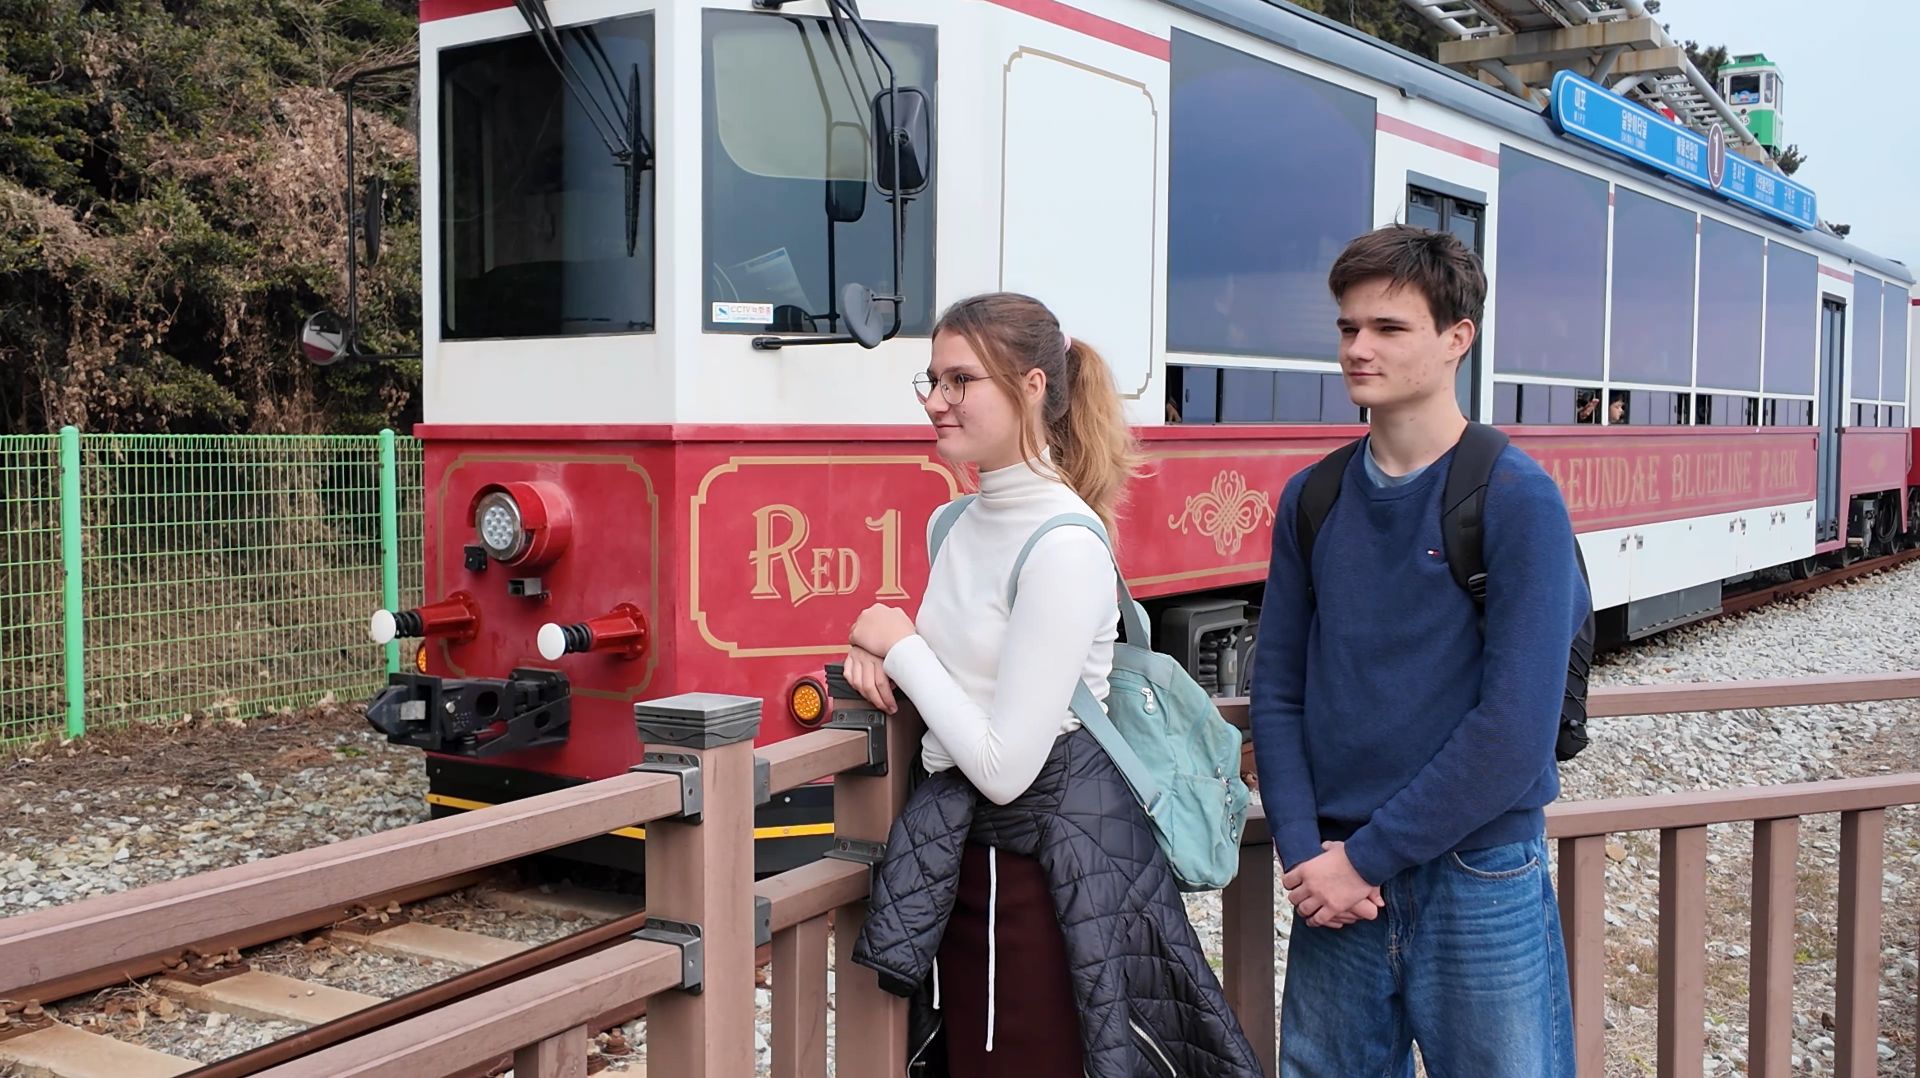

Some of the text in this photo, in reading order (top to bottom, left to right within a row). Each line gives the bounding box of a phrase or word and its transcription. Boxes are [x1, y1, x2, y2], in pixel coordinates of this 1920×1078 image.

[1712, 132, 1719, 178] 1
[1536, 448, 1798, 513] AEUNDAE BLUELINE PARK
[865, 509, 911, 600] 1
